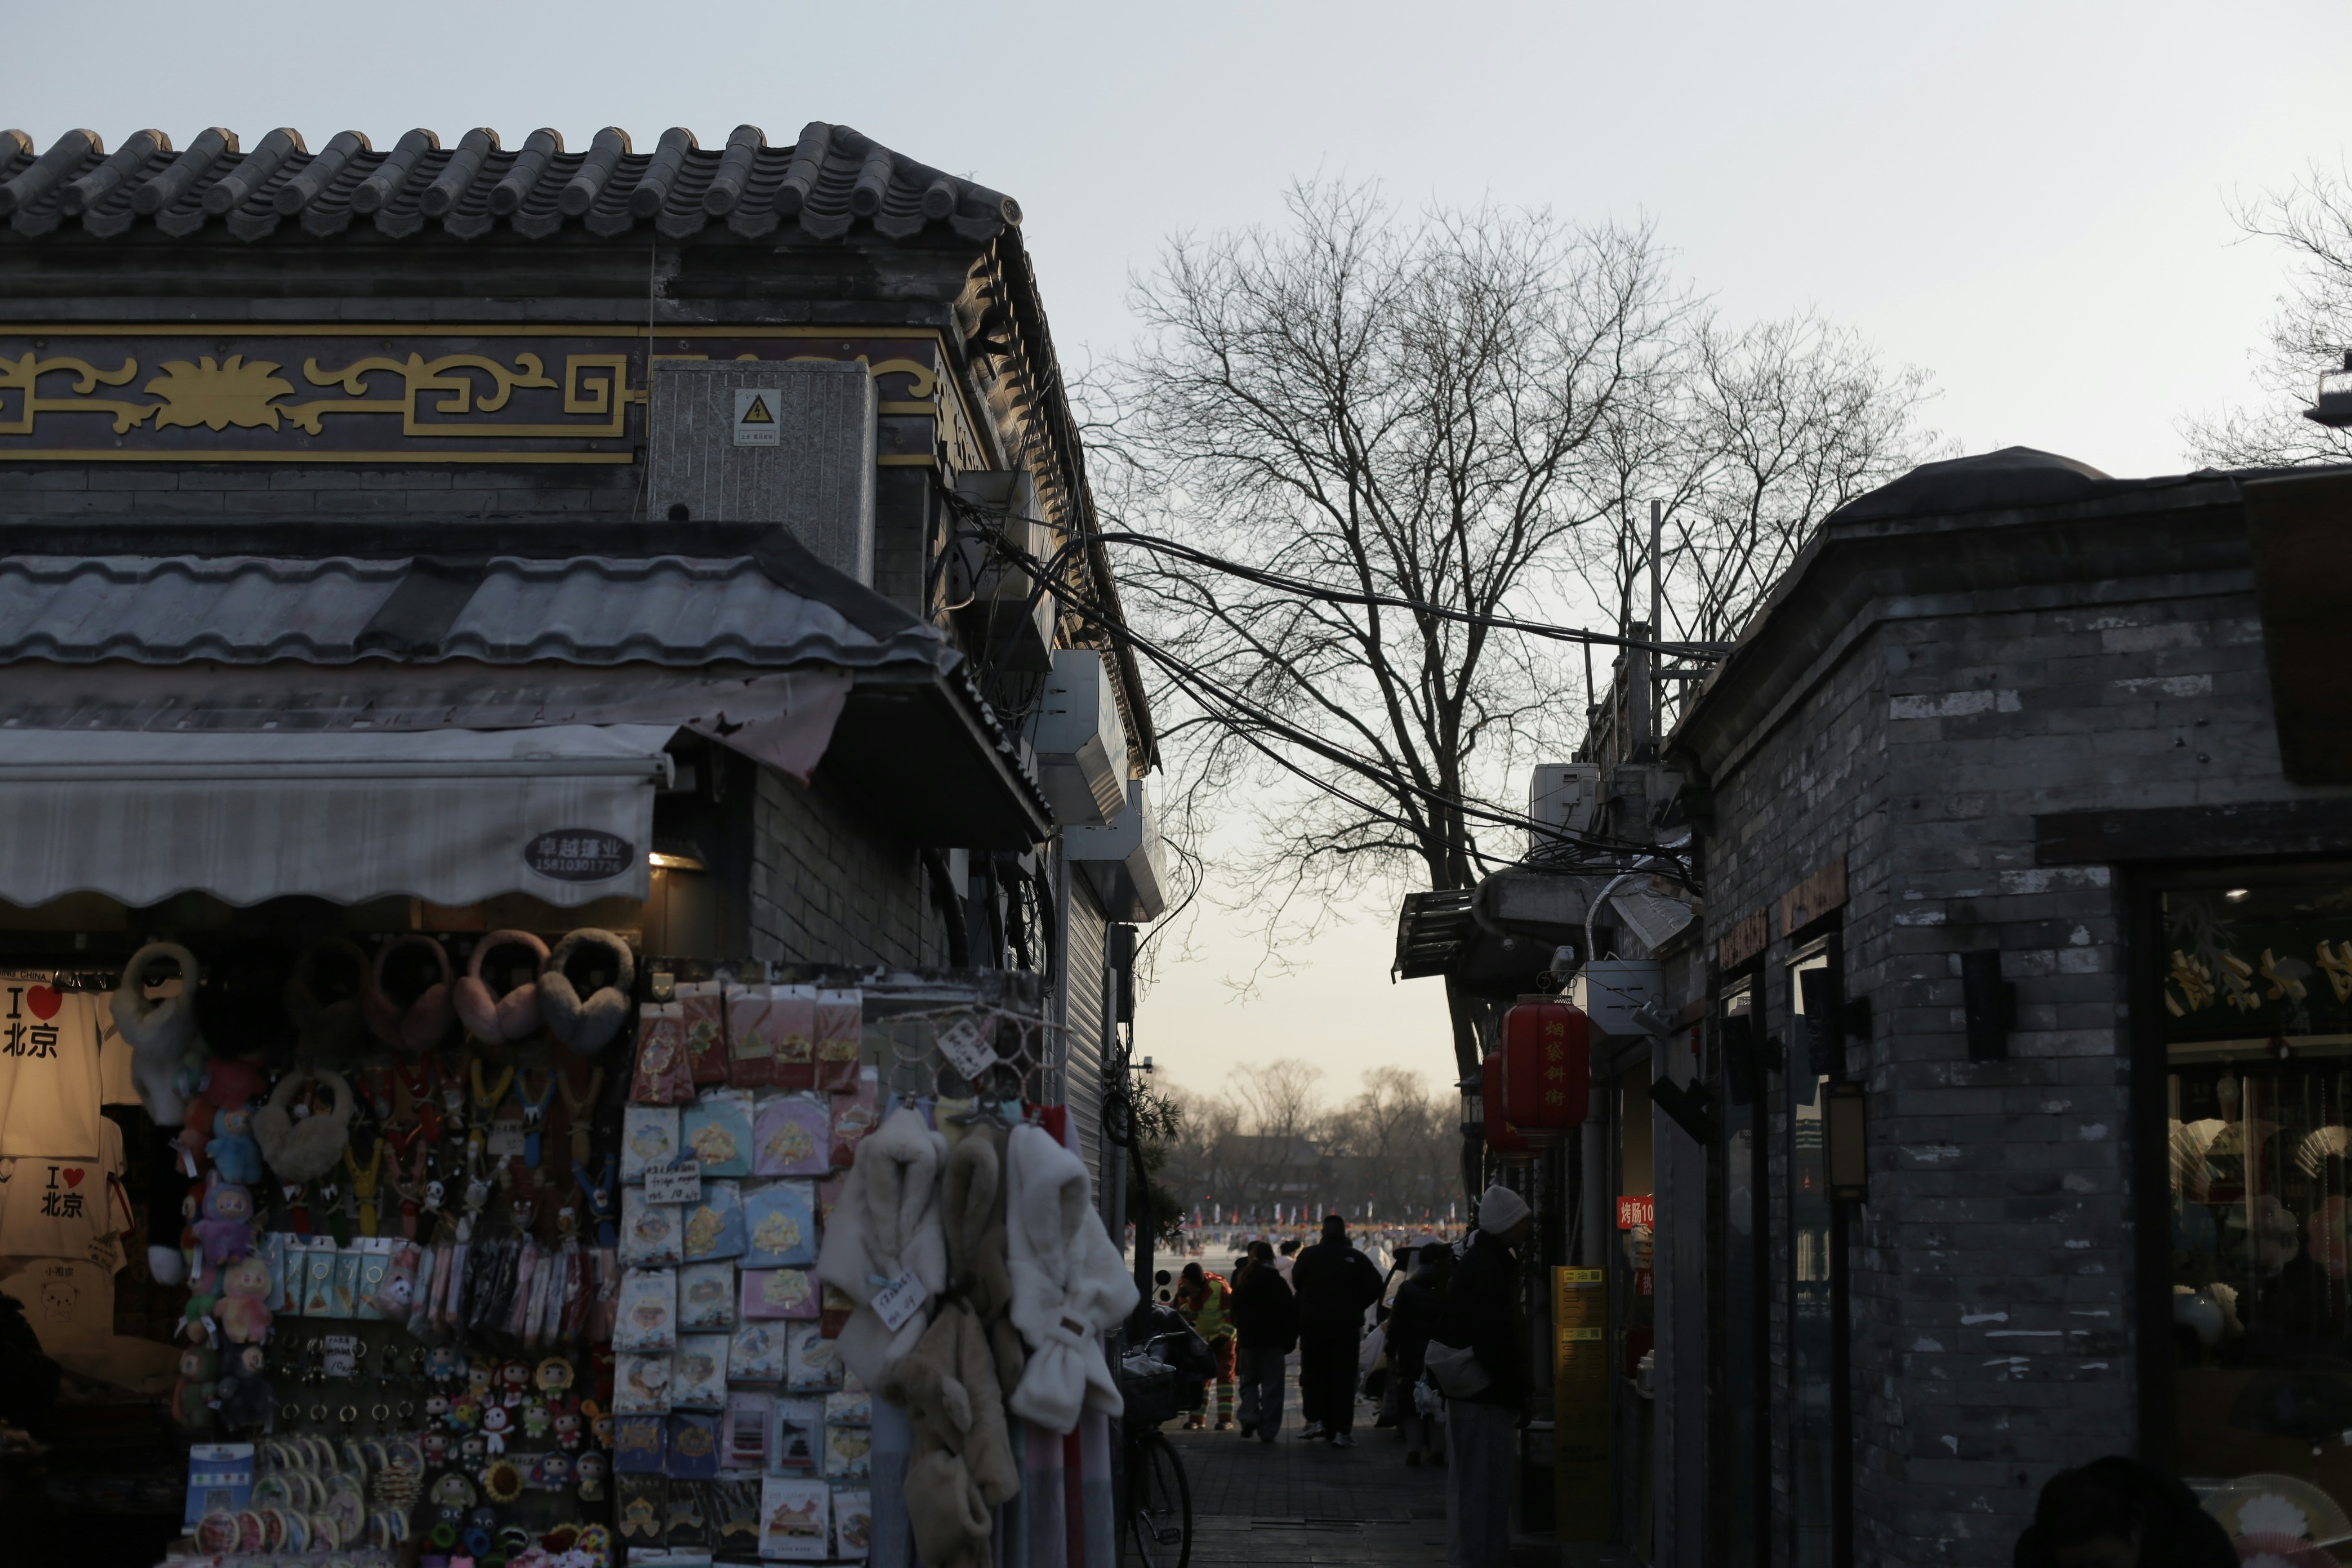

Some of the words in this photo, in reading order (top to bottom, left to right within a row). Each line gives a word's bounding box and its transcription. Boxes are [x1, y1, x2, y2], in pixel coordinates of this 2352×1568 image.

[20, 970, 47, 981] CHINA
[6, 987, 23, 1019] I
[2, 1022, 59, 1059] 北京
[1543, 1020, 1567, 1106] 烟袋斜街
[46, 1166, 60, 1189] I
[40, 1191, 83, 1219] 北京
[1621, 1202, 1654, 1224] 烤肠10
[44, 1266, 74, 1278] 小祖宗
[1643, 1273, 1652, 1295] 热
